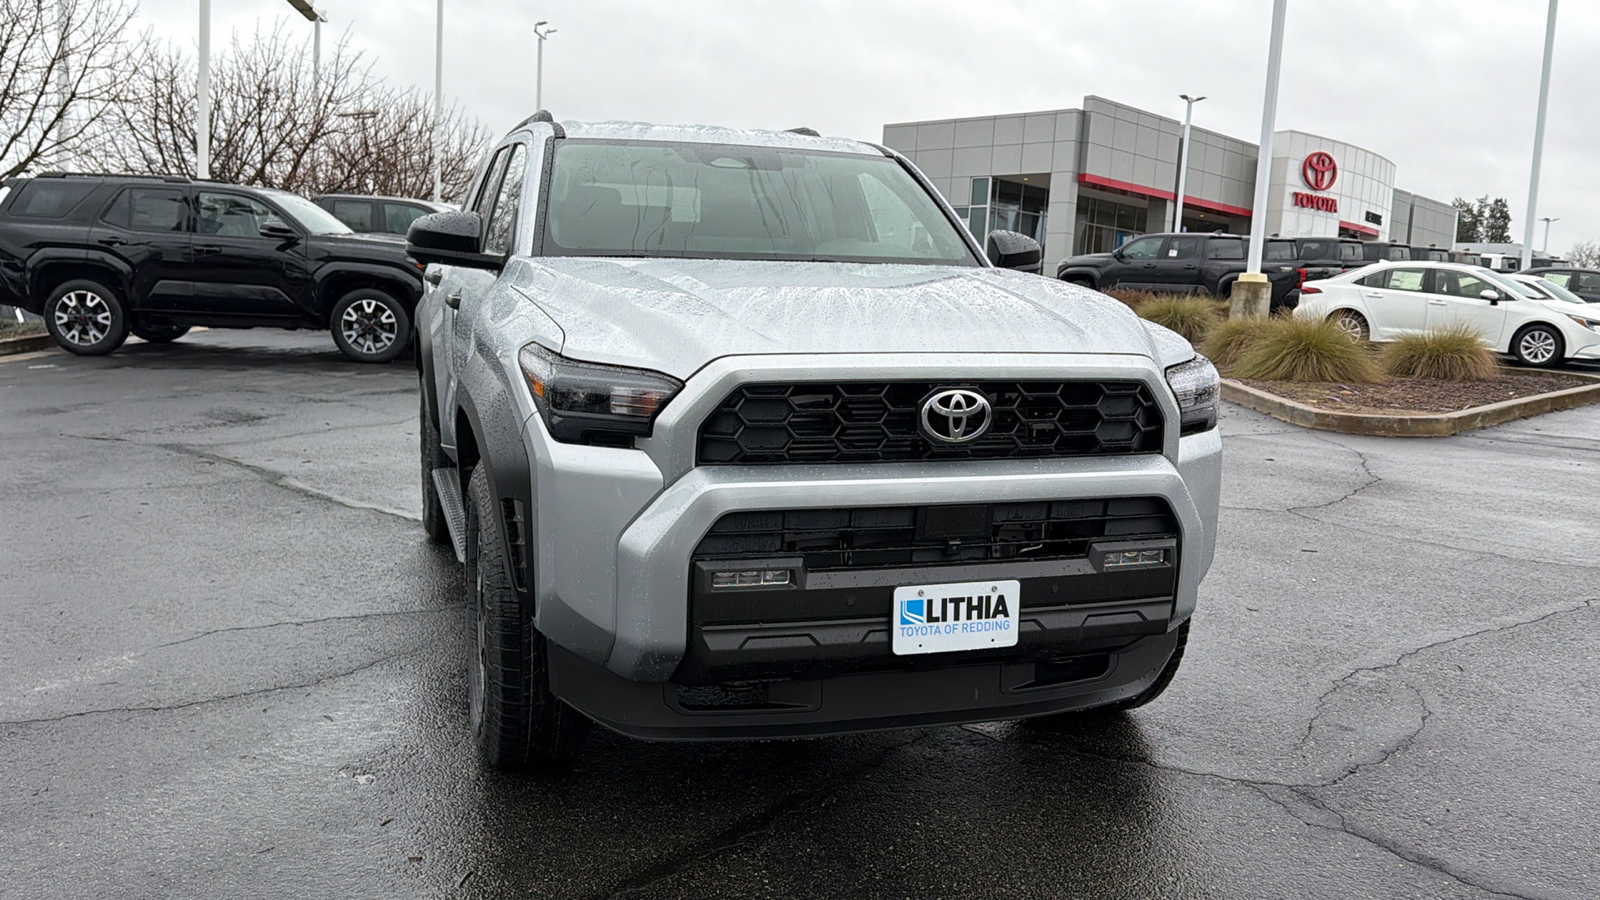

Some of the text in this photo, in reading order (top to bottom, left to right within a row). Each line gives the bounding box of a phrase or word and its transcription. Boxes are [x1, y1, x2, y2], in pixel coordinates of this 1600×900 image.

[1293, 192, 1338, 213] TOYOTA
[926, 594, 1010, 623] LITHIA
[900, 620, 1010, 637] TOYOTA OF REDDING
